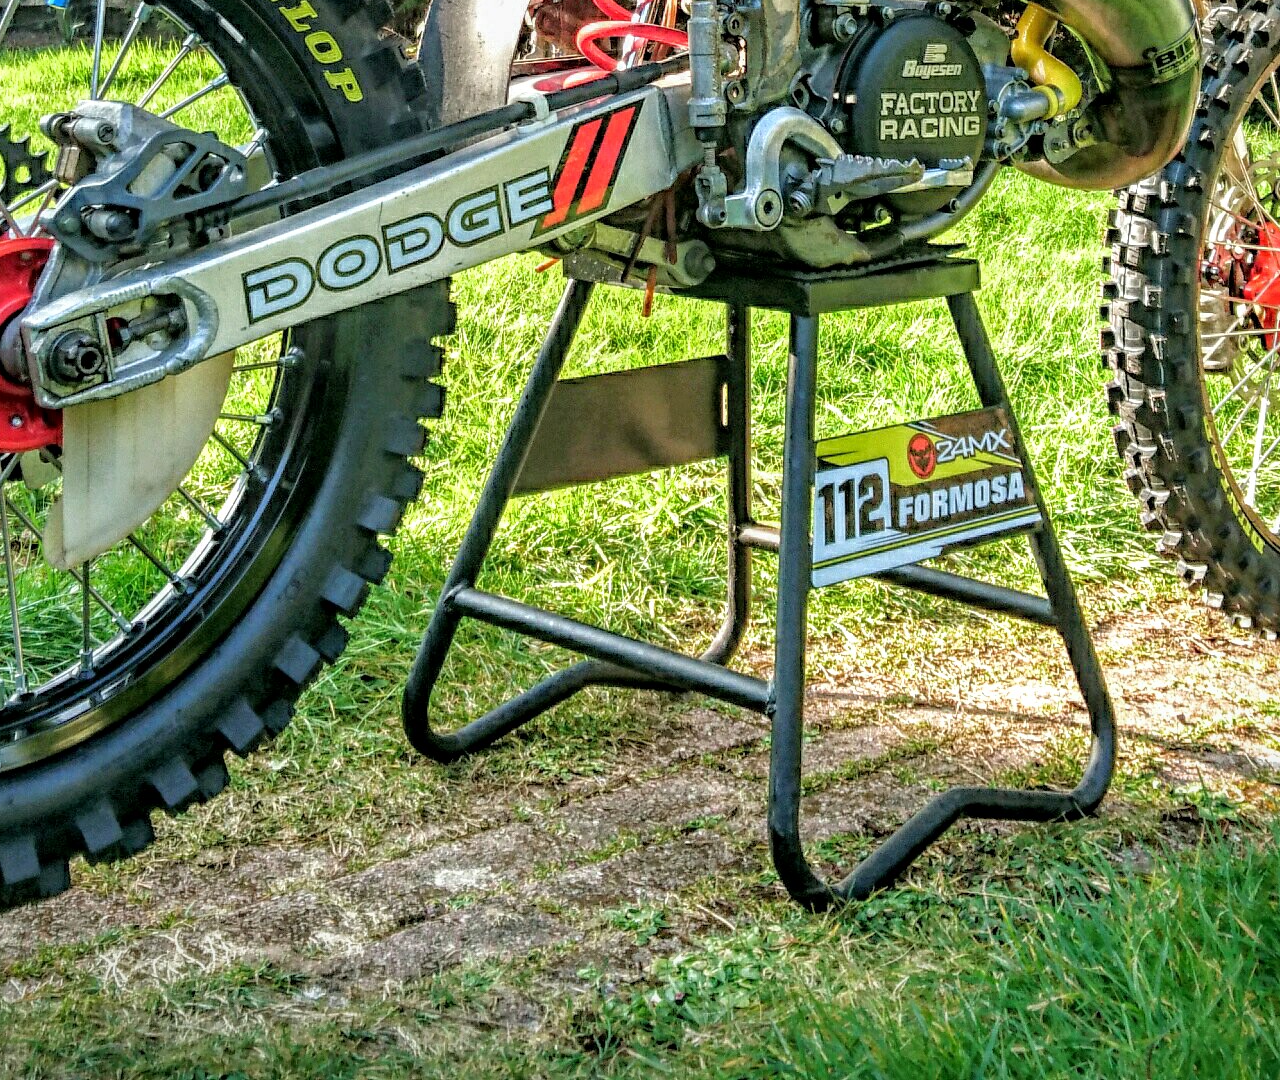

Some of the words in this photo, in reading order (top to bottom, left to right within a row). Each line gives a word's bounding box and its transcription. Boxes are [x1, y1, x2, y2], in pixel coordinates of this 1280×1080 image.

[902, 59, 963, 80] Boyesen
[880, 90, 981, 116] FACTORY
[880, 115, 980, 141] RACING
[241, 165, 555, 325] DODGE
[934, 426, 1012, 462] 24MX
[817, 471, 886, 547] 112
[897, 470, 1025, 527] FORMOSA
